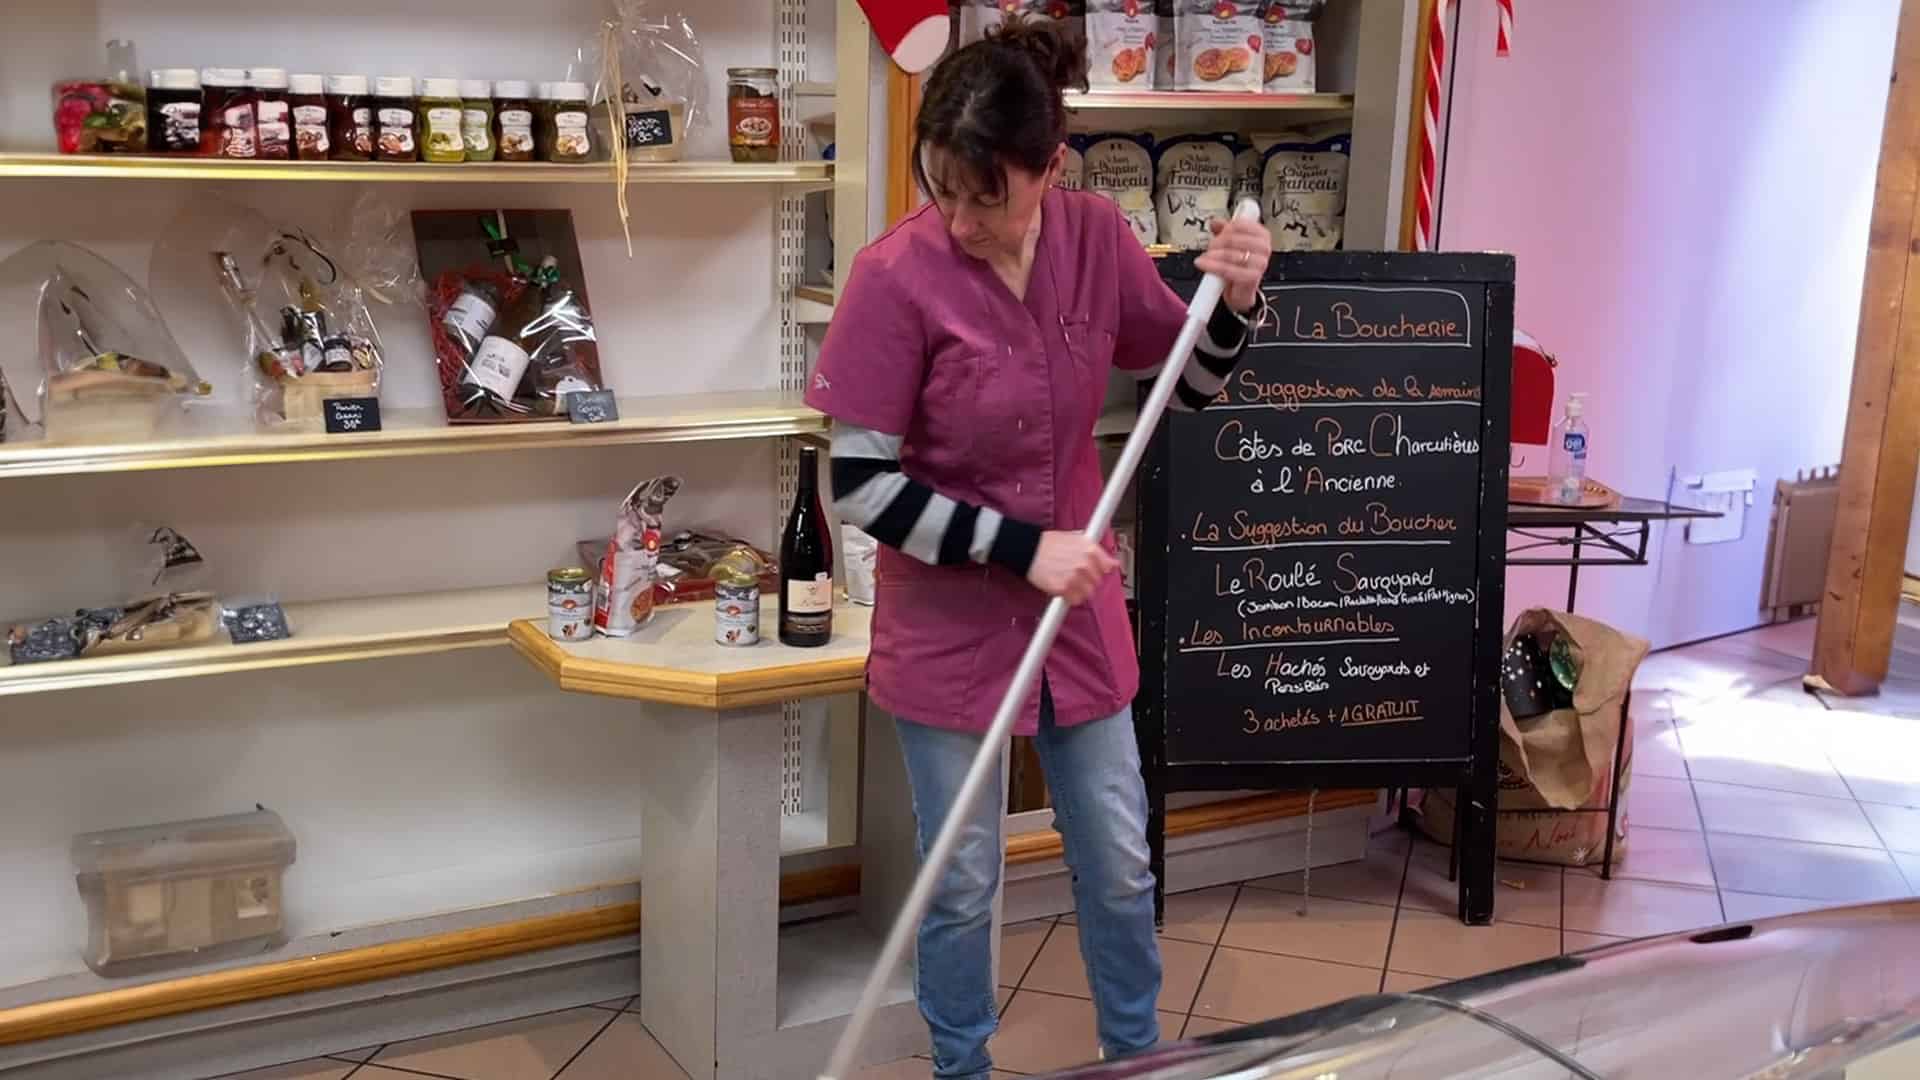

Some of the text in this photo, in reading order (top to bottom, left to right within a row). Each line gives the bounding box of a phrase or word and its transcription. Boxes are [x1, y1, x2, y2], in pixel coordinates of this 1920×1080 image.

[1295, 306, 1327, 340] La
[1331, 303, 1462, 338] Boucherie
[1239, 370, 1363, 412] Suggestion
[1372, 378, 1399, 398] de
[1215, 419, 1283, 462] Côtes
[1291, 439, 1316, 456] de
[1250, 468, 1264, 493] à
[1192, 503, 1457, 549] La Suggestion du Boucher
[1216, 553, 1434, 597] Le Roulé Savoyard
[1191, 620, 1223, 646] Les
[1217, 652, 1251, 678] Les
[1265, 653, 1326, 676] Hachés
[1414, 661, 1431, 678] et
[1243, 709, 1259, 733] 3
[1264, 708, 1320, 732] achetés
